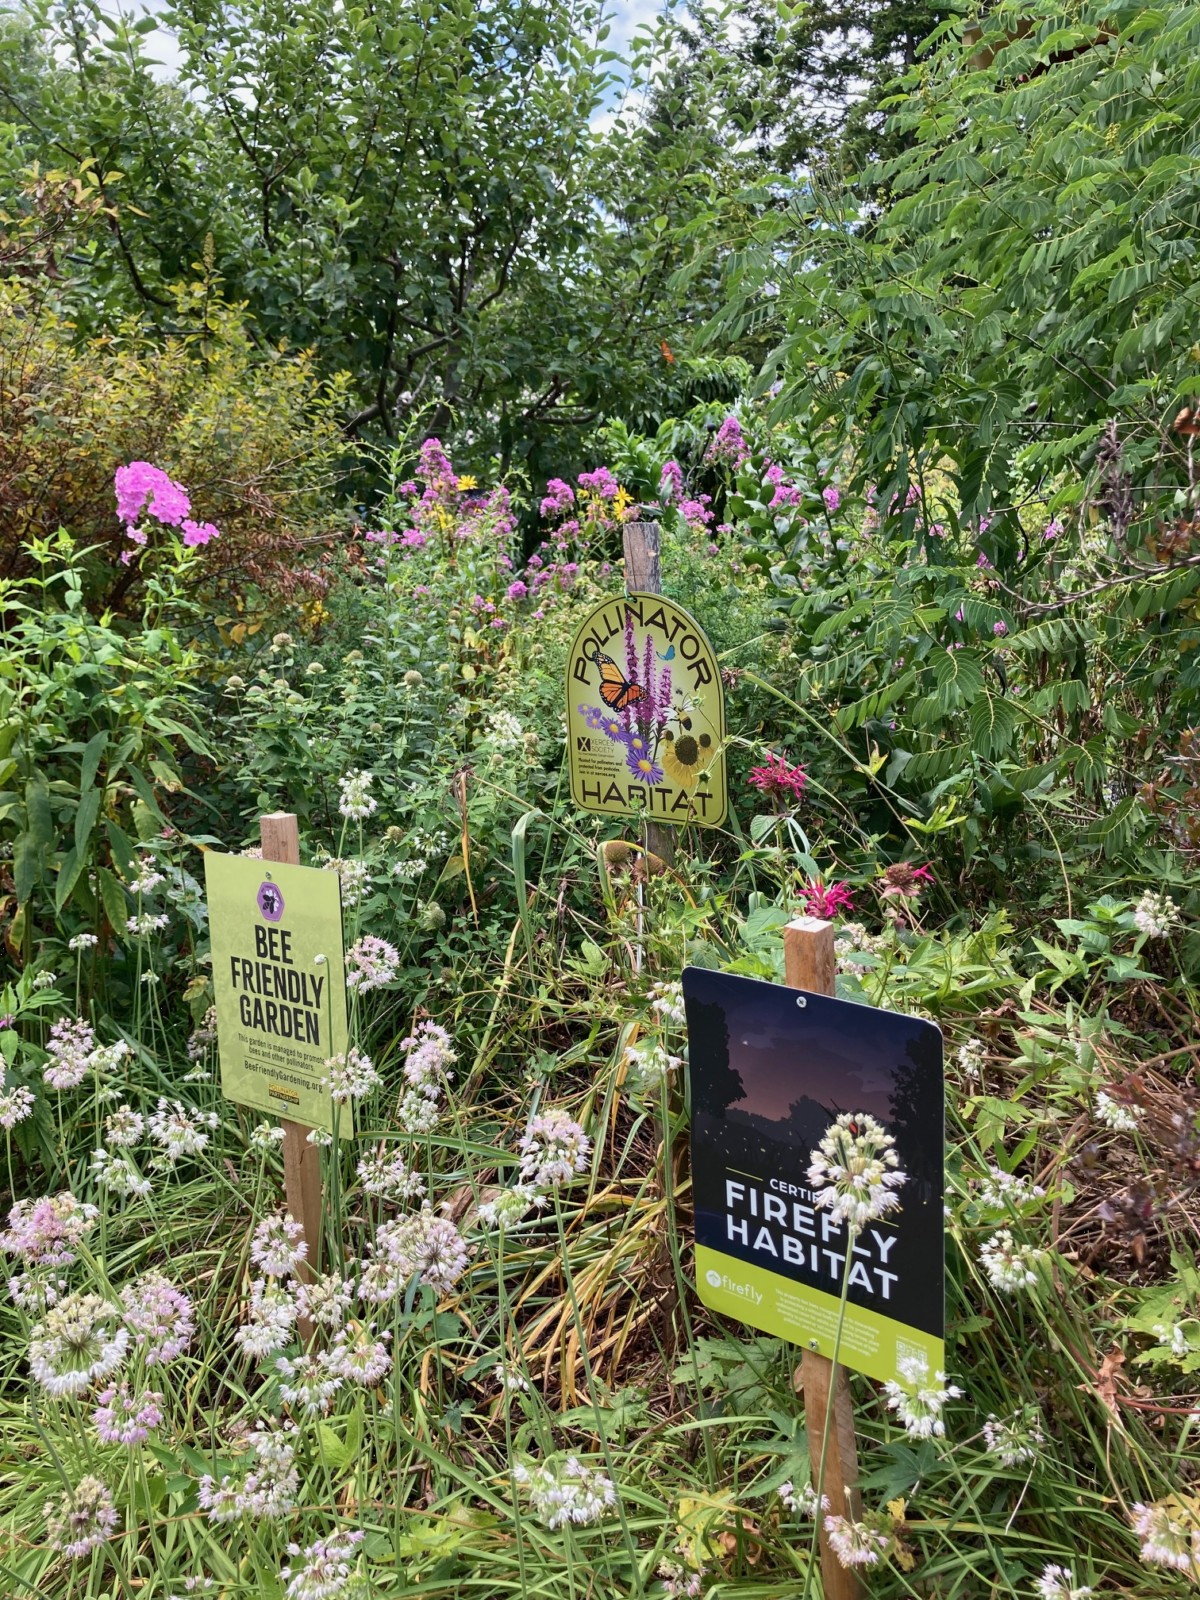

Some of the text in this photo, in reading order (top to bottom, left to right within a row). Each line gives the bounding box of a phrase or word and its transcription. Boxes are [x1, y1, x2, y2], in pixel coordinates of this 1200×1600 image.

[573, 601, 712, 691] POLLINATOR
[592, 746, 615, 754] SOCIETY
[581, 779, 713, 817] HABITAT
[254, 924, 294, 965] BEE
[230, 955, 325, 1010] FRIENDLY
[239, 994, 320, 1046] GARDEN
[238, 1032, 249, 1043] This
[249, 1037, 267, 1048] garden
[267, 1042, 272, 1050] is
[273, 1044, 296, 1057] managed
[296, 1050, 303, 1058] to
[249, 1045, 315, 1072] bees and other pollinators.
[244, 1060, 323, 1093] BeeFriendlyGardening.org
[269, 1083, 298, 1097] POLLINATOR
[269, 1090, 299, 1104] PARTNERSHIP
[769, 1178, 835, 1209] CERTIF
[726, 1179, 898, 1264] FIREFLY
[727, 1213, 899, 1300] HABITAT
[722, 1275, 763, 1306] firefly
